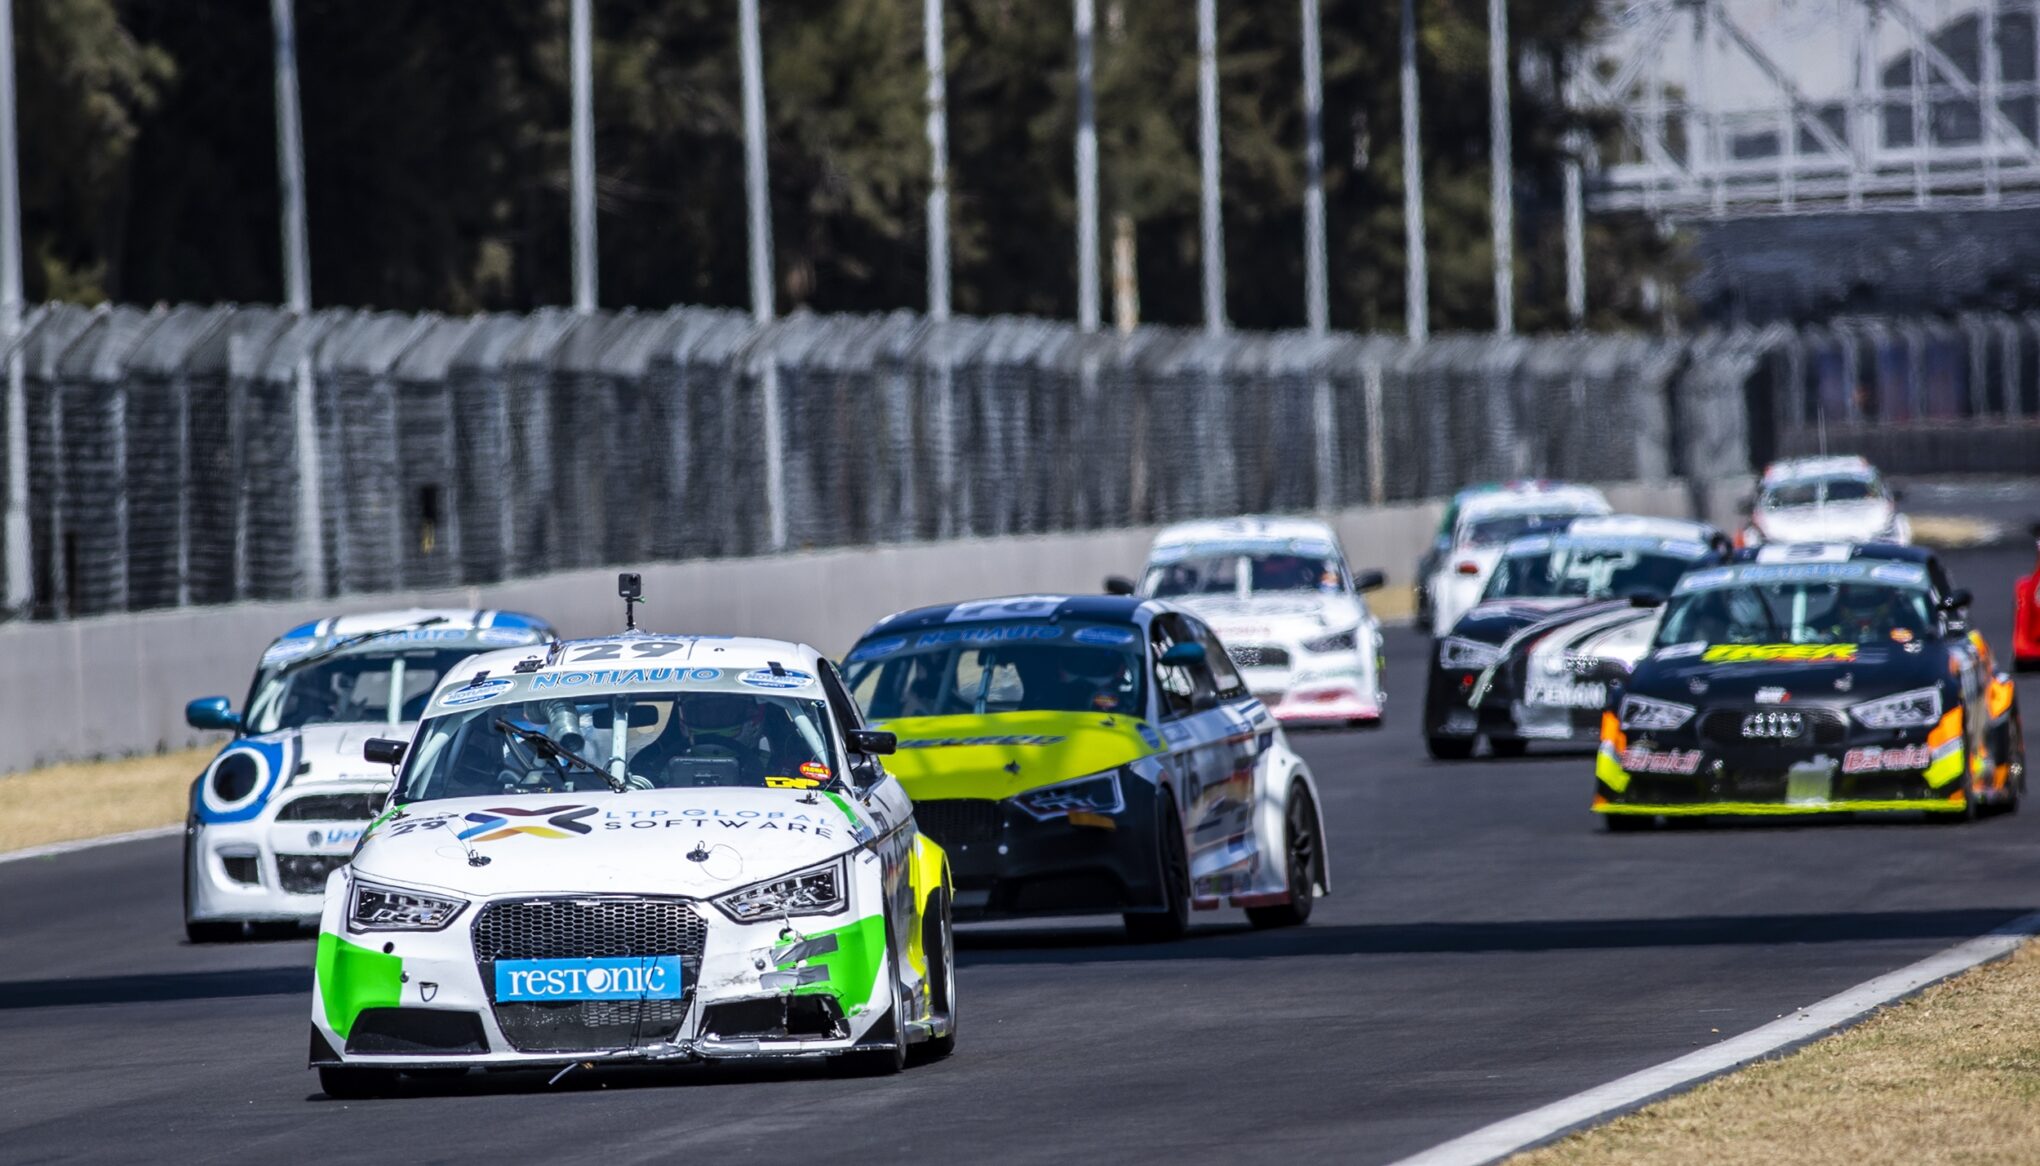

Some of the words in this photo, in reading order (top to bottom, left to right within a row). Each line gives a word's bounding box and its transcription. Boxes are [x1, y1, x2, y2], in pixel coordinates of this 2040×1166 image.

[569, 641, 684, 663] 29
[528, 666, 721, 691] NOTIAUTO
[606, 810, 669, 819] LTP
[682, 808, 834, 827] GLOBAL
[388, 820, 447, 838] 29
[604, 818, 833, 839] SOFTWARE
